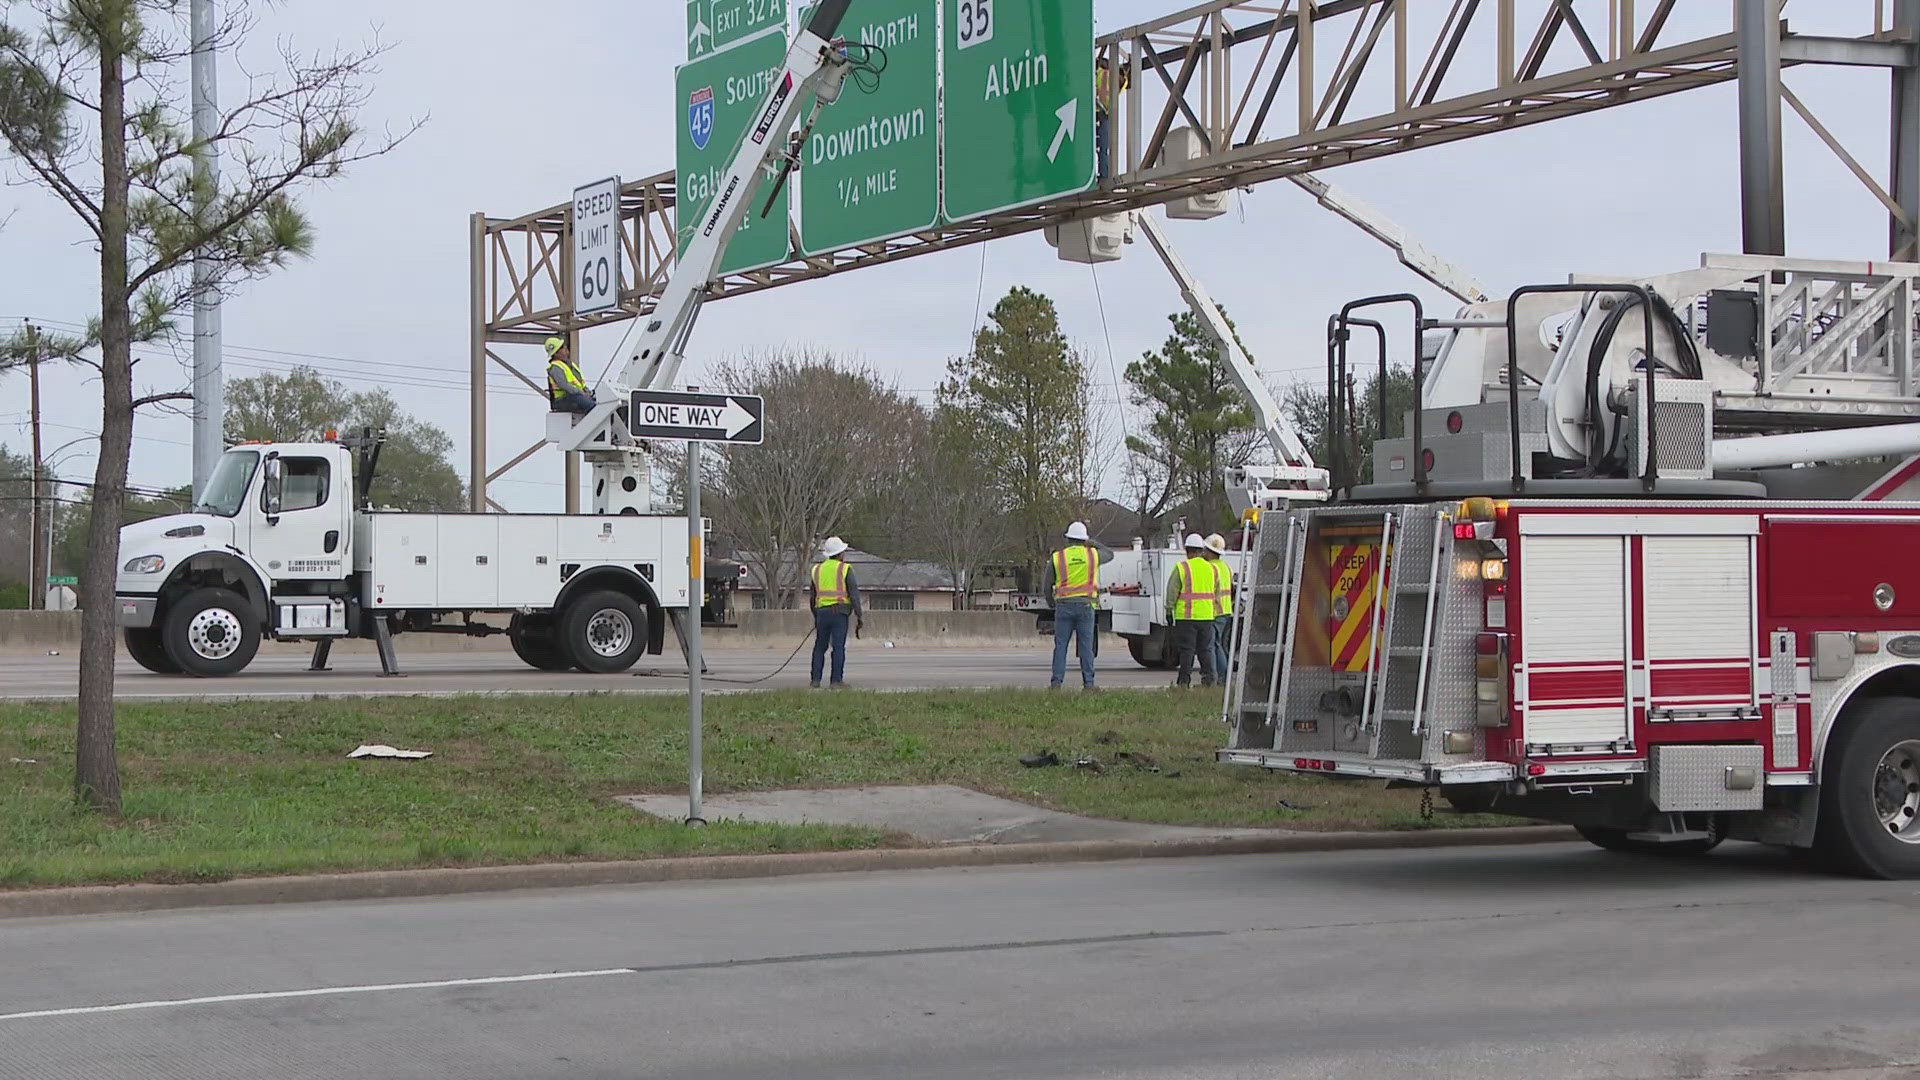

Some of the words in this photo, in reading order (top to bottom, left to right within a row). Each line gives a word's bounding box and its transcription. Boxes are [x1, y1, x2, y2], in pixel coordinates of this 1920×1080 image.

[717, 7, 741, 33] EXIT
[861, 13, 918, 57] NORTH
[960, 0, 989, 42] 35
[984, 48, 1048, 101] Alvin
[691, 104, 711, 136] 45
[759, 94, 785, 130] TEREX
[812, 107, 925, 166] Downtown
[577, 192, 613, 220] SPEED
[703, 175, 740, 238] COMMANDER
[837, 177, 860, 208] 1/4
[866, 169, 897, 197] MILE
[581, 224, 609, 251] LIMIT
[582, 256, 609, 300] 60
[644, 405, 680, 425] ONE
[686, 407, 723, 427] WAY
[1336, 555, 1365, 570] KEEP
